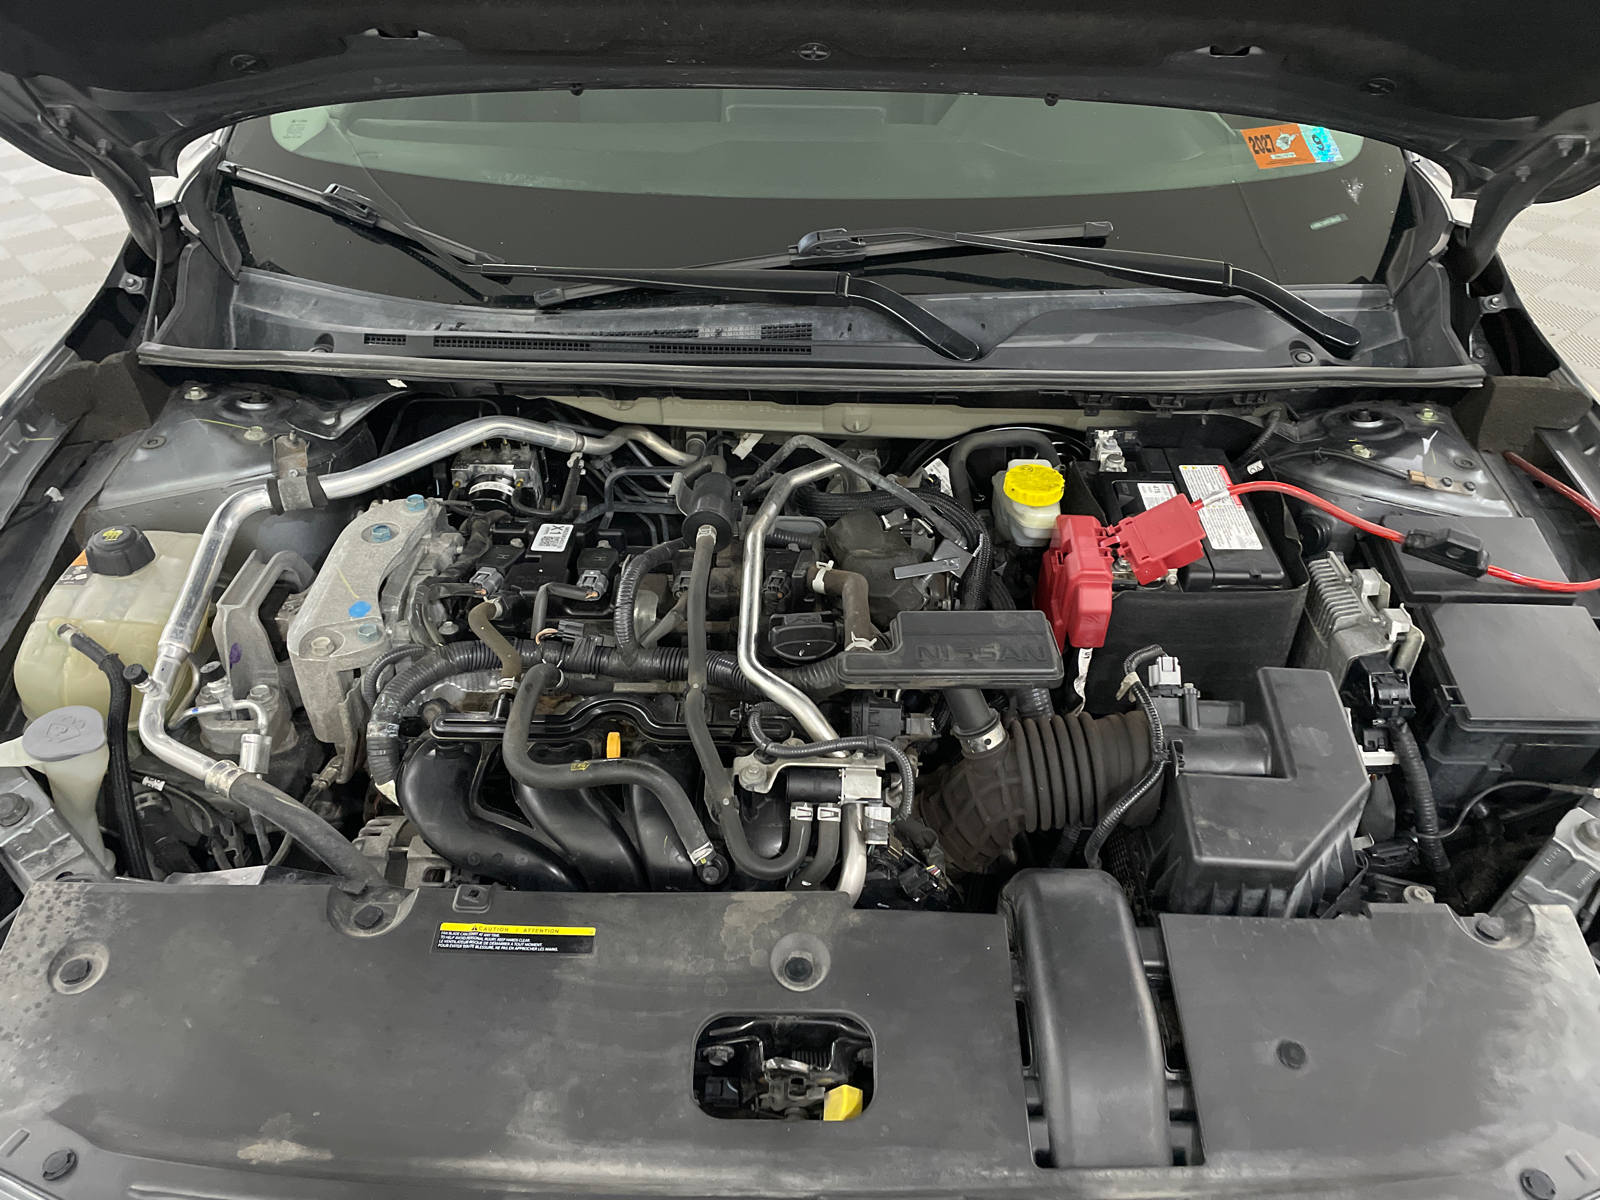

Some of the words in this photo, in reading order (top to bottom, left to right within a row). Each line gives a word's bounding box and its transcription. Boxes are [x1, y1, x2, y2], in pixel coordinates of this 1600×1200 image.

[1248, 134, 1275, 154] 2027
[1312, 134, 1325, 151] 9
[550, 525, 565, 534] X1
[916, 645, 1047, 662] NISSAN
